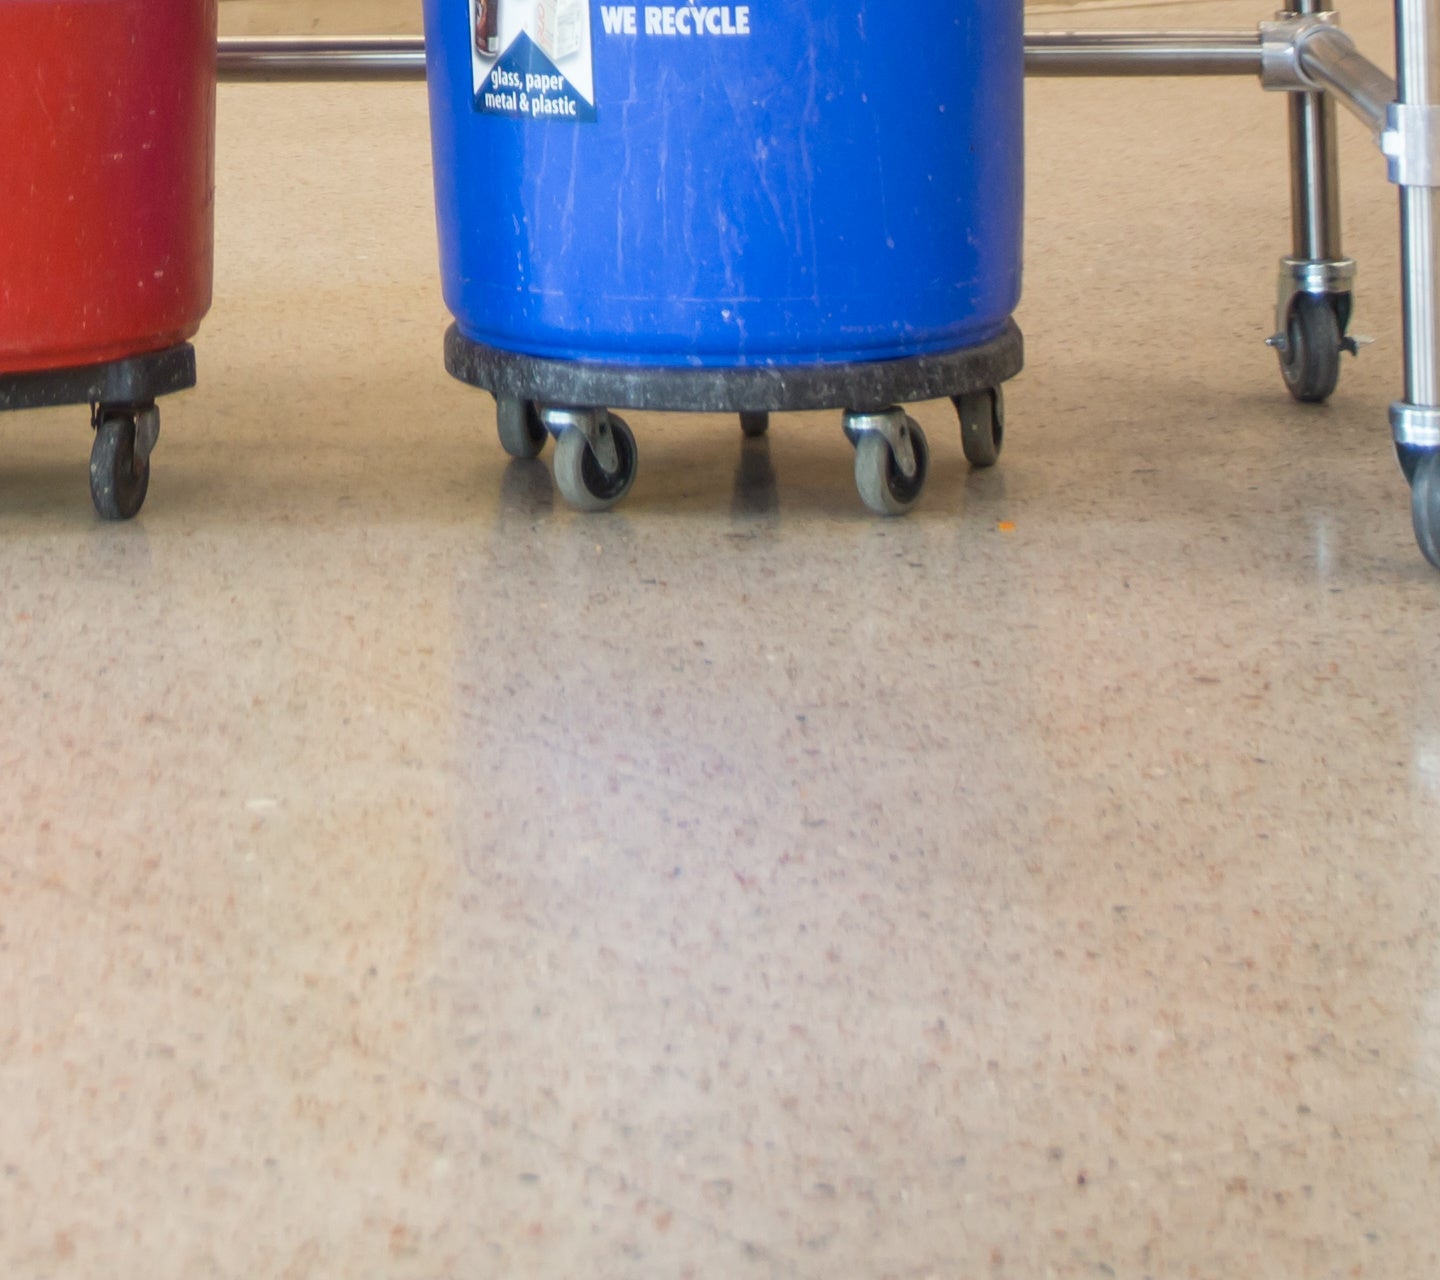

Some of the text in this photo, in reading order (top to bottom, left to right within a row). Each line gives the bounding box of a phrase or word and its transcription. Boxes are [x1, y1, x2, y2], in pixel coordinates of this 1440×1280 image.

[601, 6, 750, 36] WE RECYCLE
[491, 66, 565, 94] glass, paper
[485, 91, 576, 117] metal & plastic
